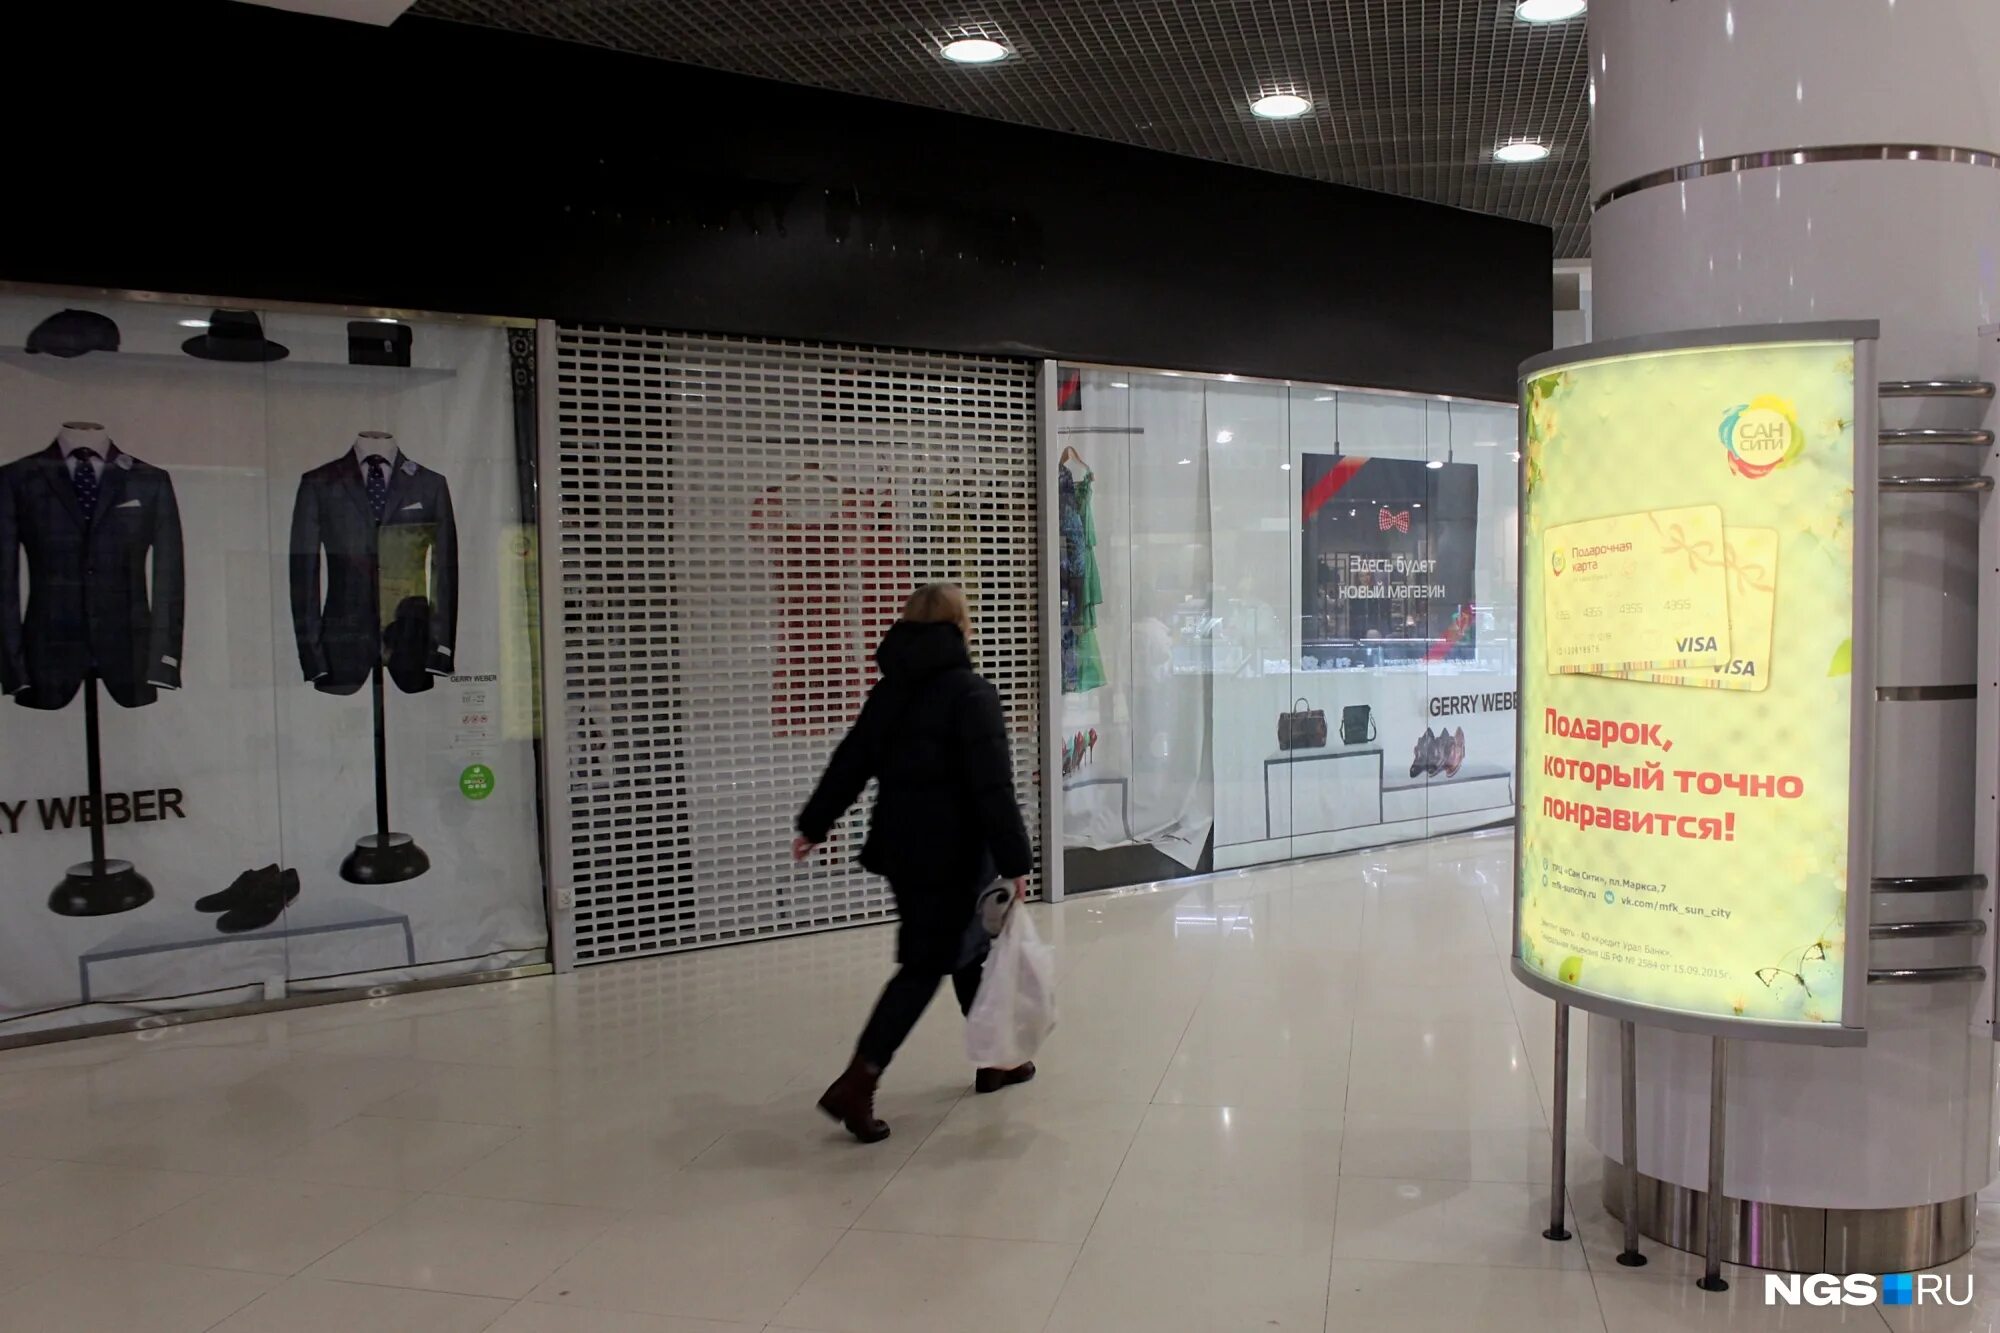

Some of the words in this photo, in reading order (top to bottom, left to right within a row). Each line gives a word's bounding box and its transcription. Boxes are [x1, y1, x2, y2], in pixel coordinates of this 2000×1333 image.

[1740, 422, 1784, 439] САН
[1740, 439, 1784, 451] СИТИ
[1572, 542, 1633, 558] Подарочная
[1350, 555, 1393, 573] Здесь
[1396, 555, 1436, 576] будет
[1572, 561, 1598, 573] карта
[1339, 581, 1384, 599] новый
[1388, 585, 1445, 599] магазин
[1676, 636, 1718, 652] VISA
[1430, 694, 1478, 717] GERRY
[1545, 707, 1673, 752] Подарок,
[1544, 754, 1664, 791] который
[1673, 770, 1804, 799] точно
[1543, 795, 1735, 842] понравится!
[1551, 880, 1597, 899] mfk-suncity.ru
[1621, 896, 1731, 919] vk.com/mfk_sun_city
